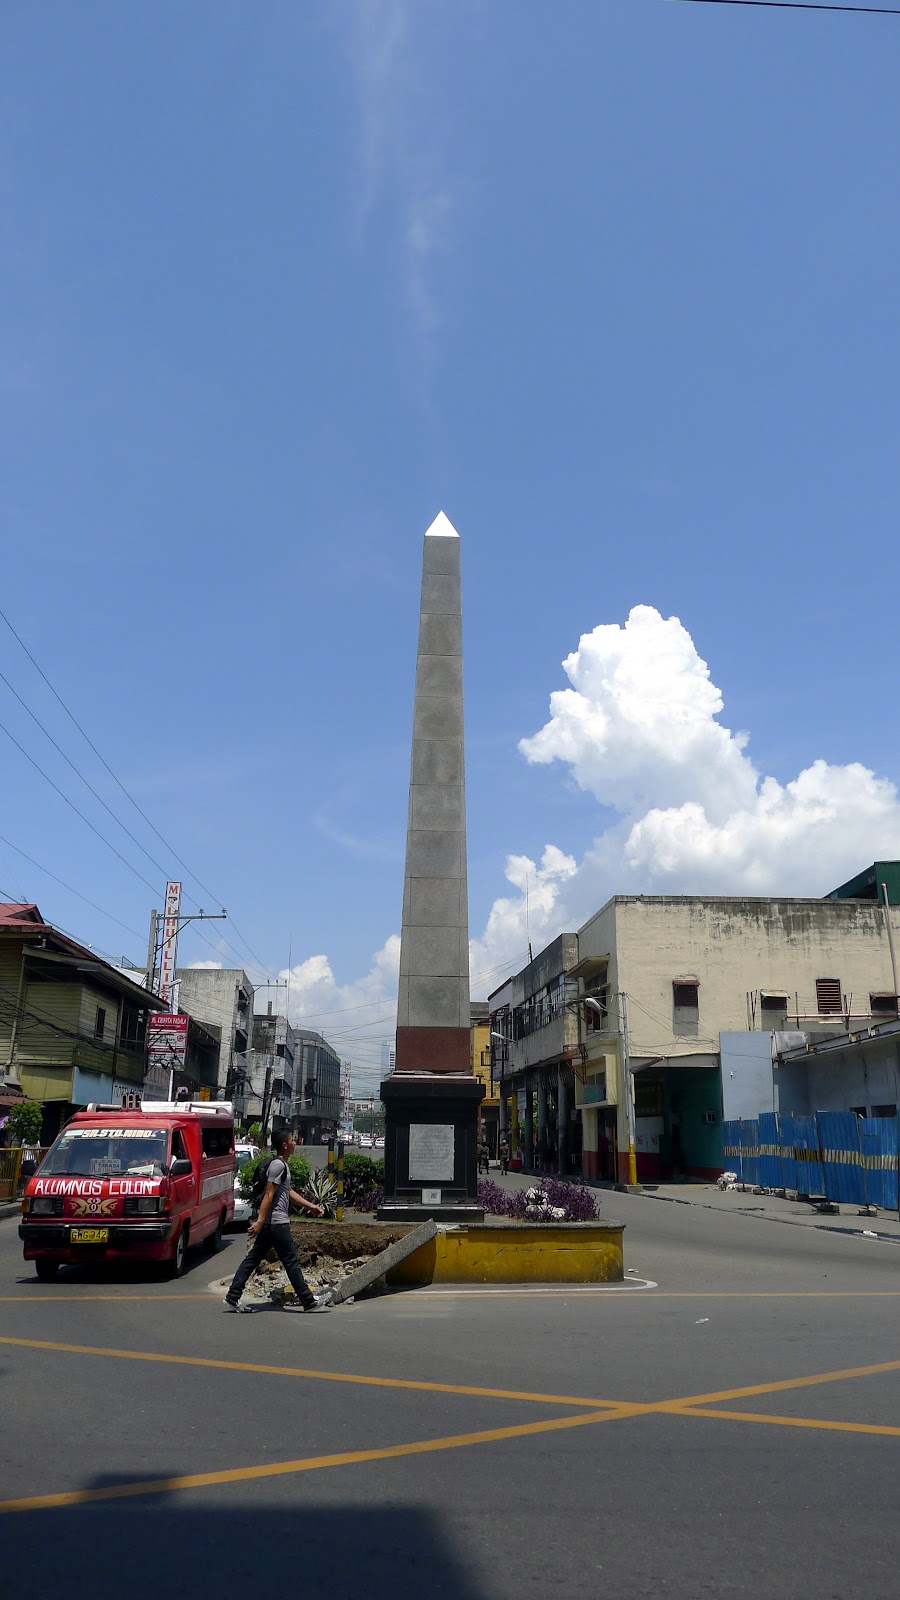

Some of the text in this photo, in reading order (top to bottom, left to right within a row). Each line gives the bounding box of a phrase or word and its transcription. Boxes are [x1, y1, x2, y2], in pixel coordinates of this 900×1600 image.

[168, 885, 178, 894] M
[34, 1180, 153, 1195] ALUMNOS COLON
